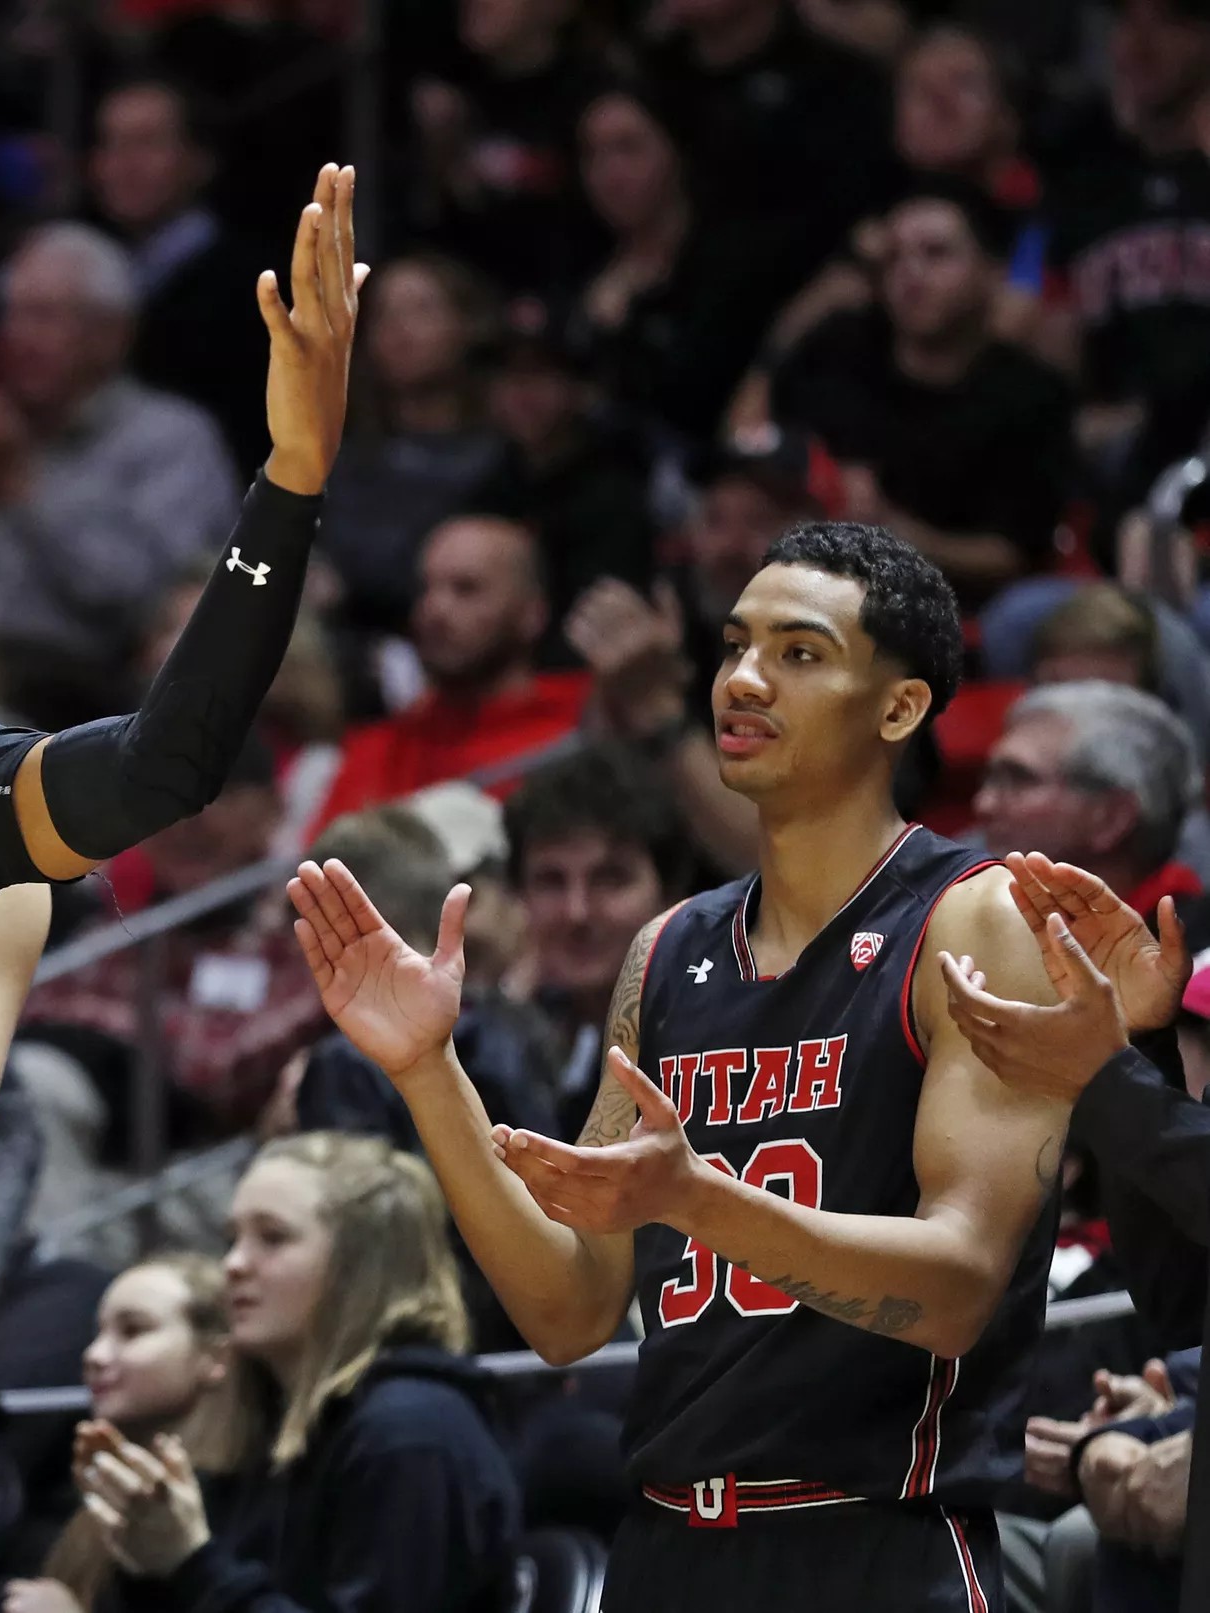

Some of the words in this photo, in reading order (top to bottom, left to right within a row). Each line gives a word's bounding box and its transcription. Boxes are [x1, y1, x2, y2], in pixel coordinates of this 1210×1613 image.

[850, 932, 884, 956] PAC
[854, 947, 872, 963] 12
[659, 1033, 848, 1126] UTAH
[693, 1477, 726, 1520] U
